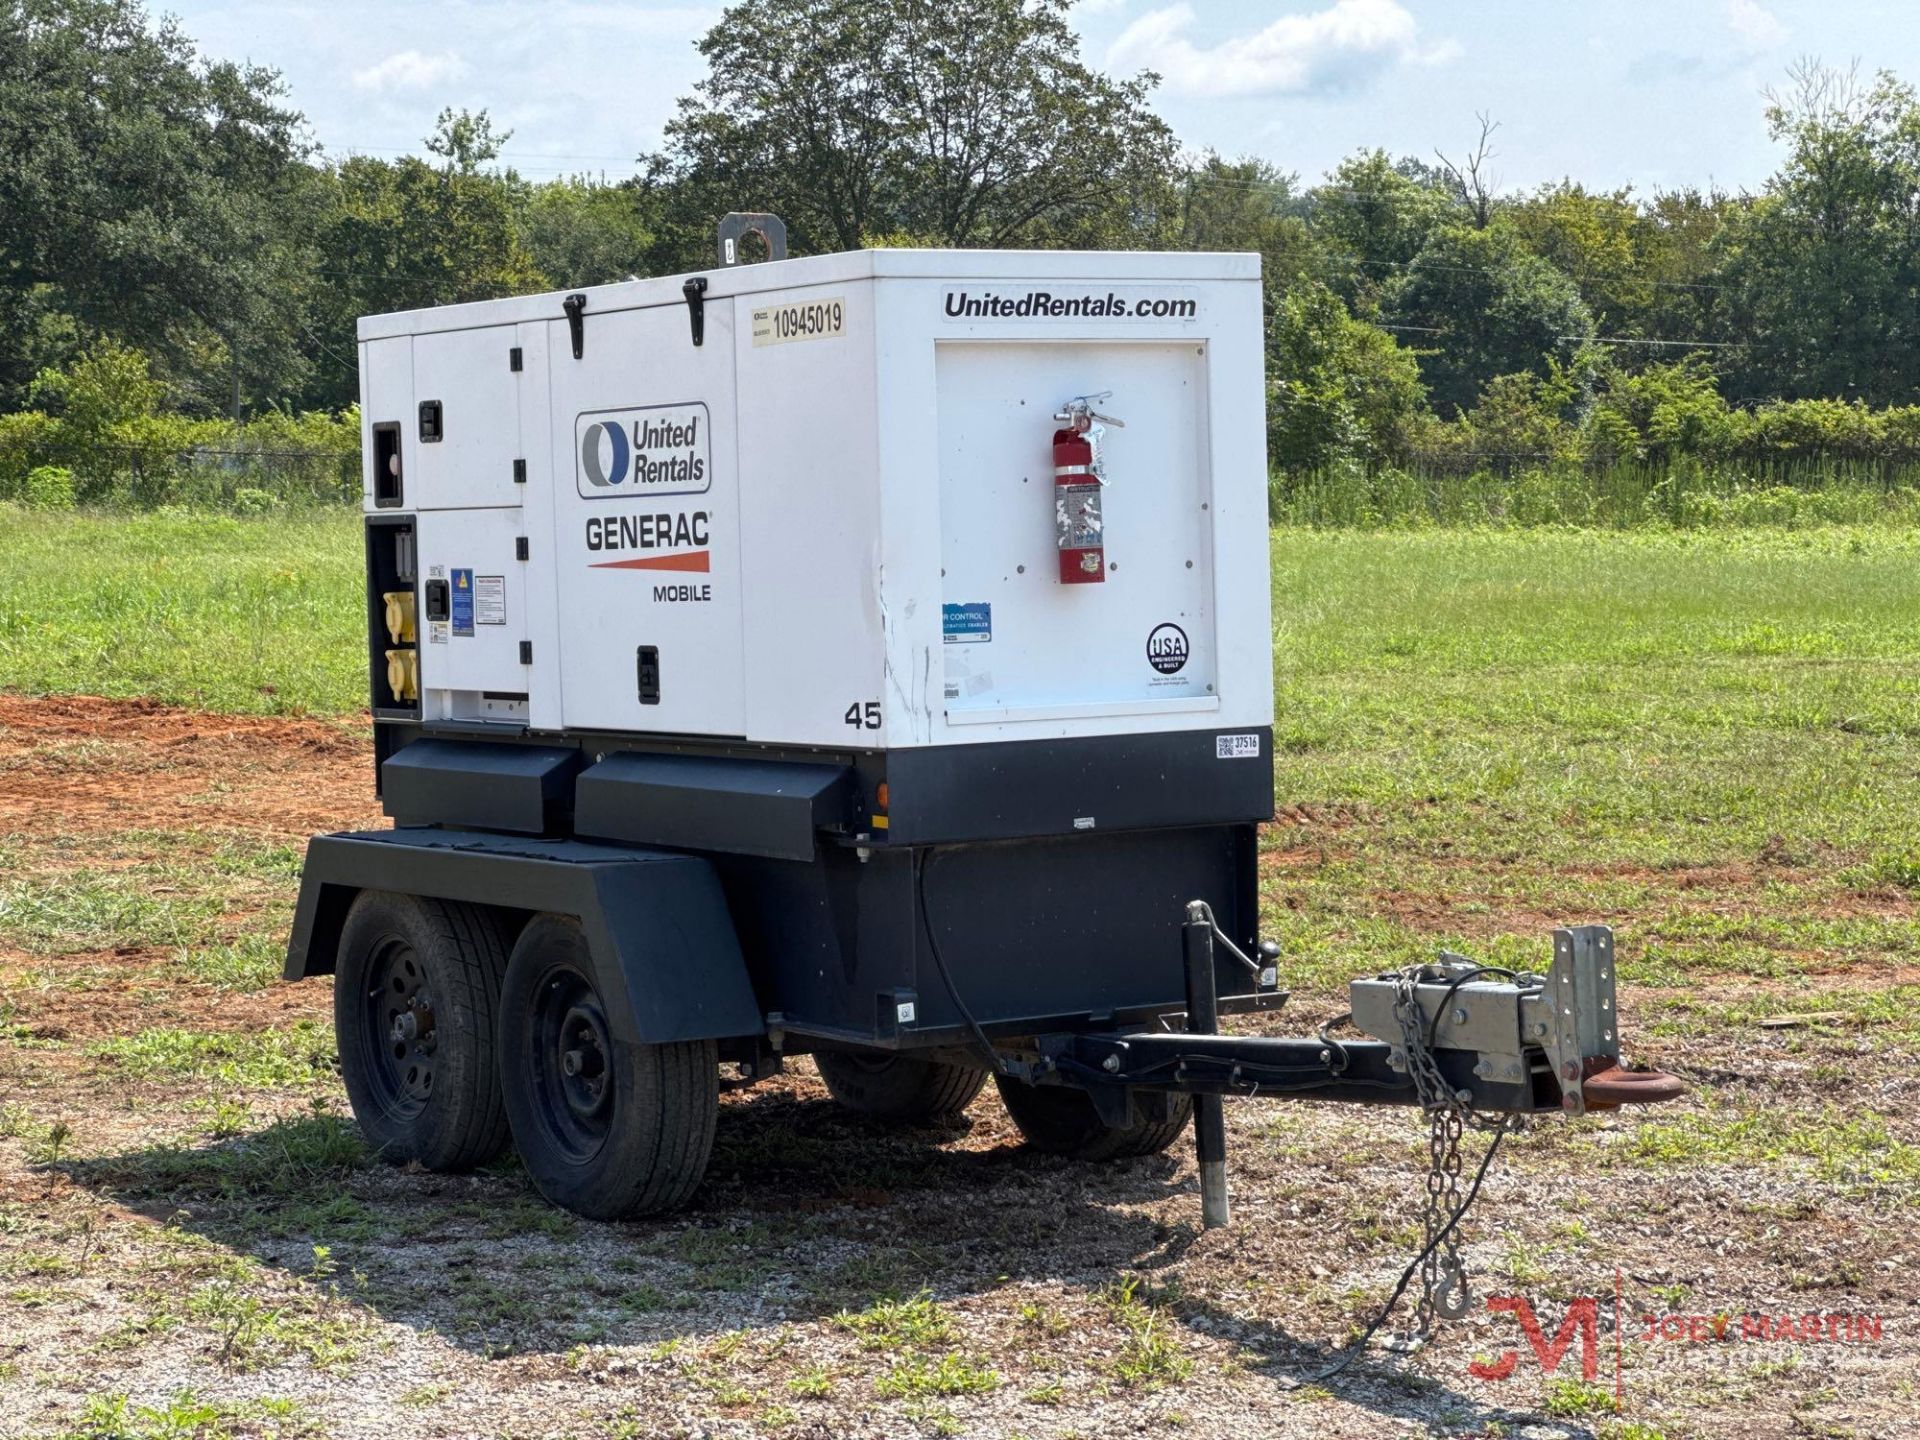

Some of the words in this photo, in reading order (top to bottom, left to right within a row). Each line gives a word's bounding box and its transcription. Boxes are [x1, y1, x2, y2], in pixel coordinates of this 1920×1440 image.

[945, 293, 1196, 318] UnitedRentals.com
[774, 303, 842, 338] 10945019
[633, 416, 697, 450] United
[634, 451, 704, 484] Rentals
[586, 511, 709, 551] GENERAC
[653, 585, 711, 602] MOBILE
[950, 612, 983, 621] CONTROL
[1152, 637, 1183, 655] USA
[845, 702, 882, 730] 45
[1235, 736, 1257, 748] 37516
